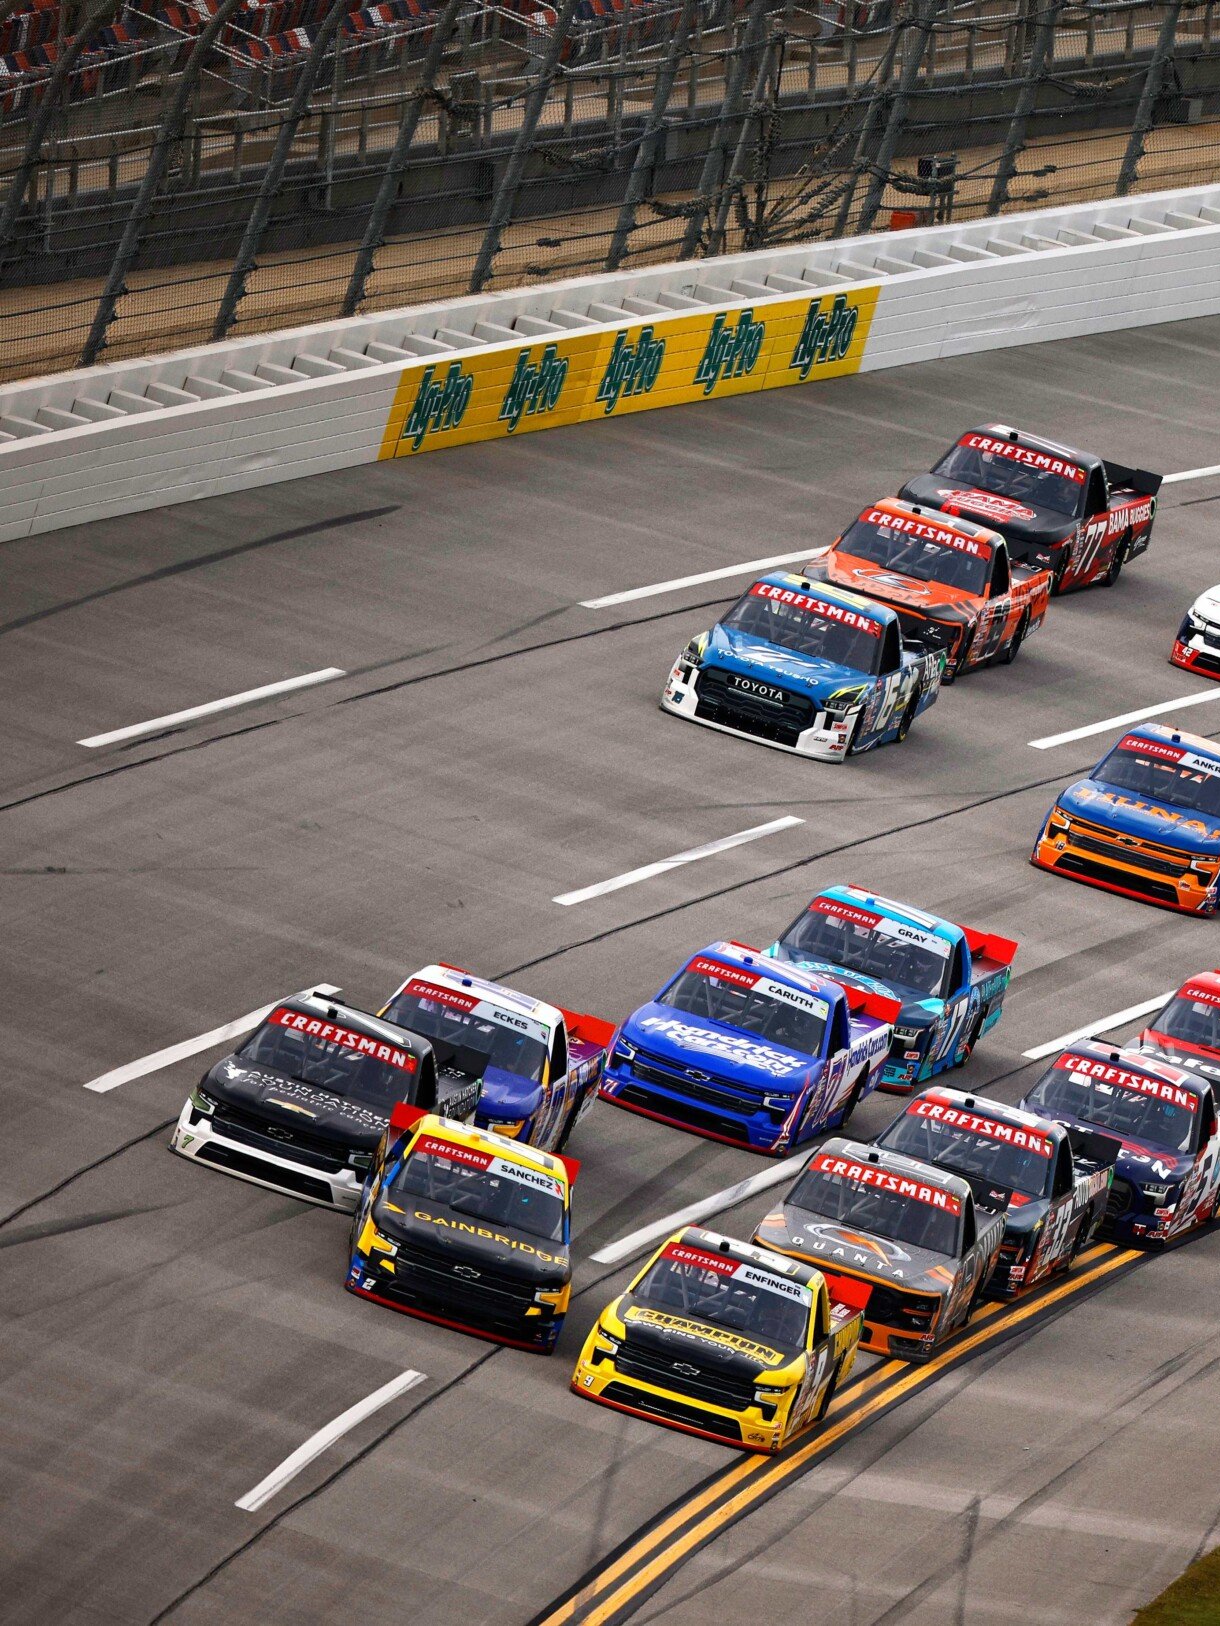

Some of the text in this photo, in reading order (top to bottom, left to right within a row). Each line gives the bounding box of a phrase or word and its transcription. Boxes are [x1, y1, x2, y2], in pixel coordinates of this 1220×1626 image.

[694, 307, 765, 396] Ag-Pro
[789, 294, 859, 381] Ag-Pro
[498, 343, 570, 433] Ag-Pro
[595, 325, 666, 415] Ag-Pro
[401, 361, 475, 451] Ag-Pro
[968, 436, 1077, 478] CRAFTSMAN
[868, 511, 980, 554] CRAFTSMAN
[1108, 508, 1129, 535] BAMA
[1074, 520, 1107, 576] 77
[758, 584, 871, 631] CRAFTSMAN
[717, 648, 765, 669] TOYOTA
[1181, 647, 1193, 656] 42
[734, 677, 783, 701] TOYOTA
[1126, 739, 1181, 759] CRAFTSMAN
[818, 902, 927, 944] CRAFTSMAN GRAY
[413, 984, 528, 1030] CRAFTSMAN ECKES
[697, 962, 813, 1009] CRAFTSMAN CARUTH
[280, 1012, 405, 1067] CRAFTSMAN
[641, 1016, 807, 1069] Hendrick
[249, 1074, 389, 1127] FOUNDATION
[251, 1071, 312, 1092] AUSTIN
[603, 1079, 617, 1092] 71
[1065, 1057, 1189, 1106] CRAFTSMAN
[181, 1136, 194, 1148] 7
[916, 1102, 1042, 1152] CRAFTSMAN
[425, 1141, 553, 1190] CRAFTSMAN SANCHEZ
[821, 1159, 947, 1207] CRAFTSMAN
[414, 1211, 569, 1267] GAINBRIDGE
[792, 1236, 904, 1278] QUANTA
[362, 1278, 376, 1291] 2
[672, 1249, 801, 1297] CRAFTSMAN ENFINGER
[636, 1309, 776, 1361] CHAMPION
[700, 1338, 735, 1354] YOUR
[583, 1376, 593, 1387] 9
